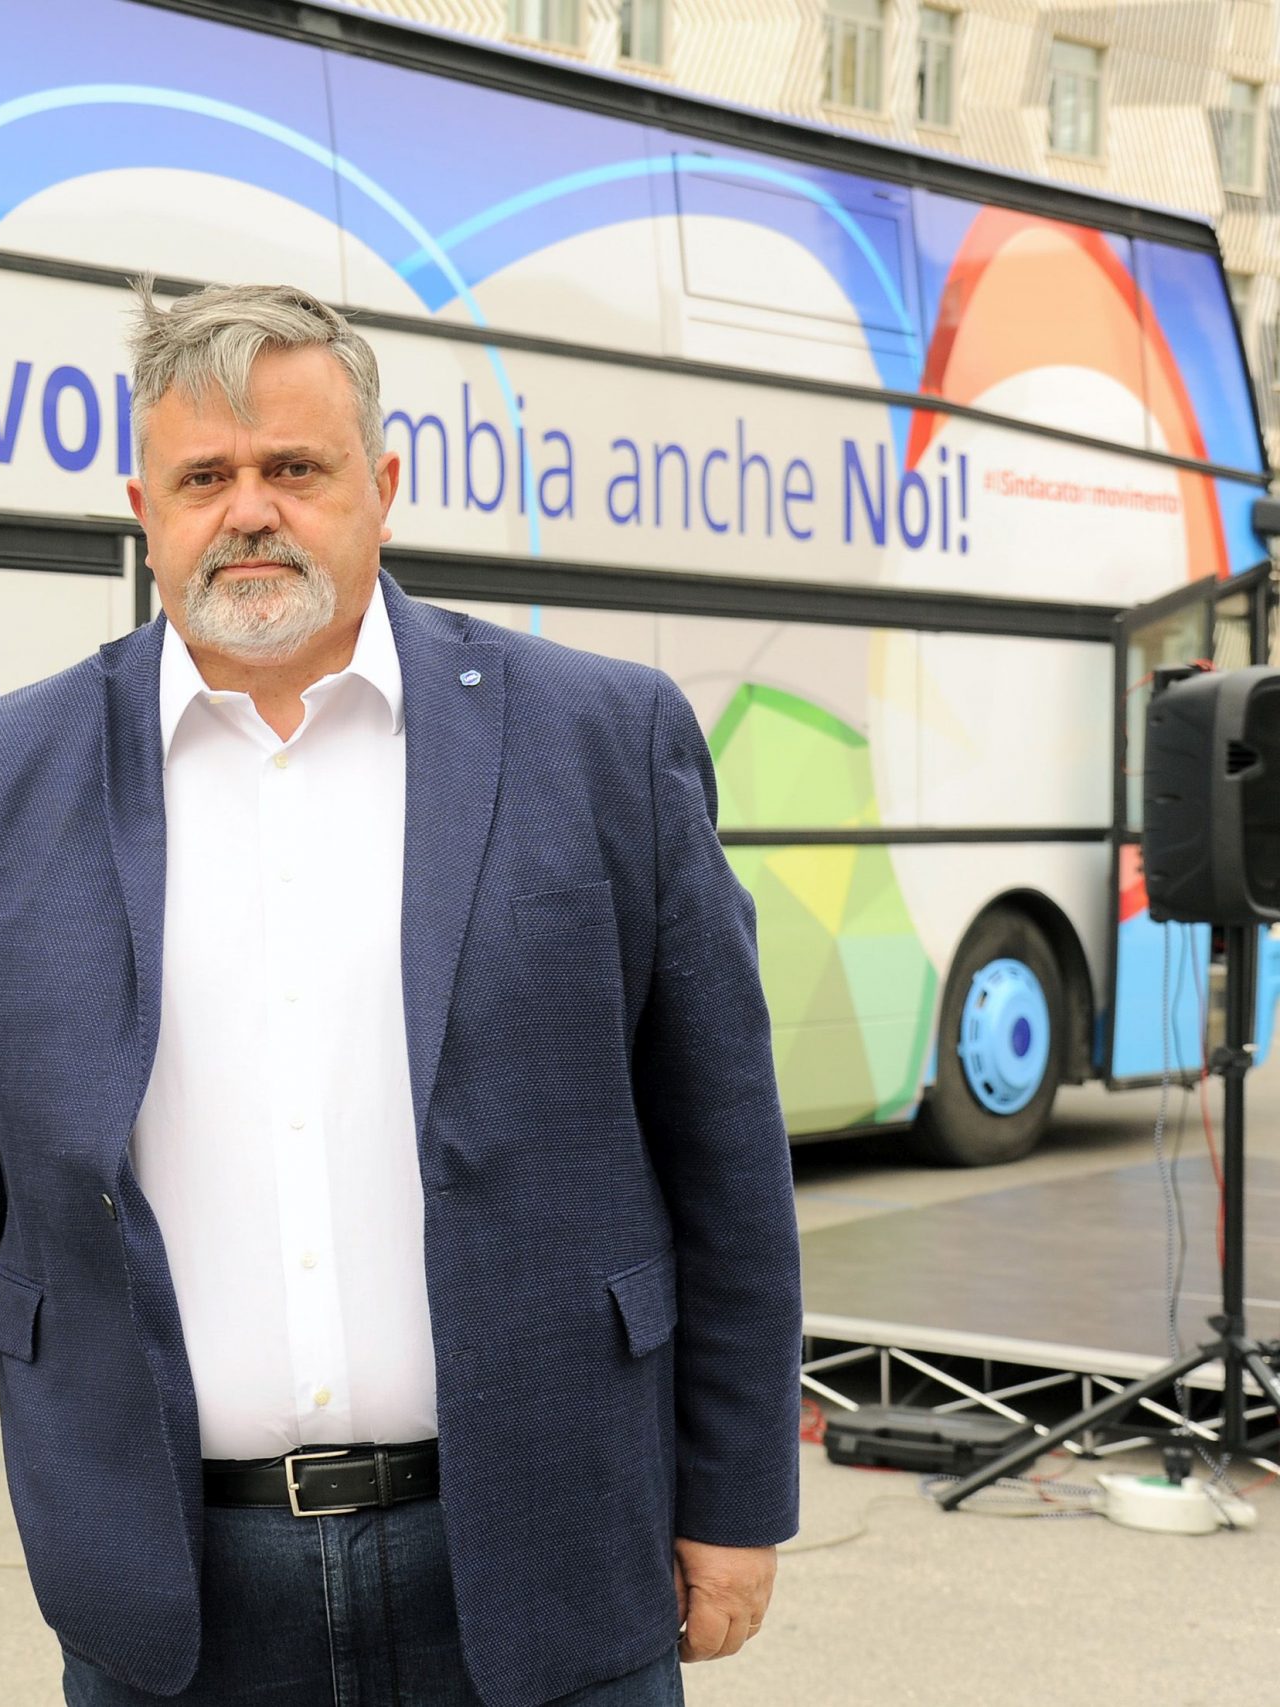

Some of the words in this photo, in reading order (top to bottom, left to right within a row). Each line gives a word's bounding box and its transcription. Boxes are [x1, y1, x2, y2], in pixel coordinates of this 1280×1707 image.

[383, 382, 575, 520] mbia
[605, 418, 816, 541] anche
[842, 438, 970, 554] Noi!
